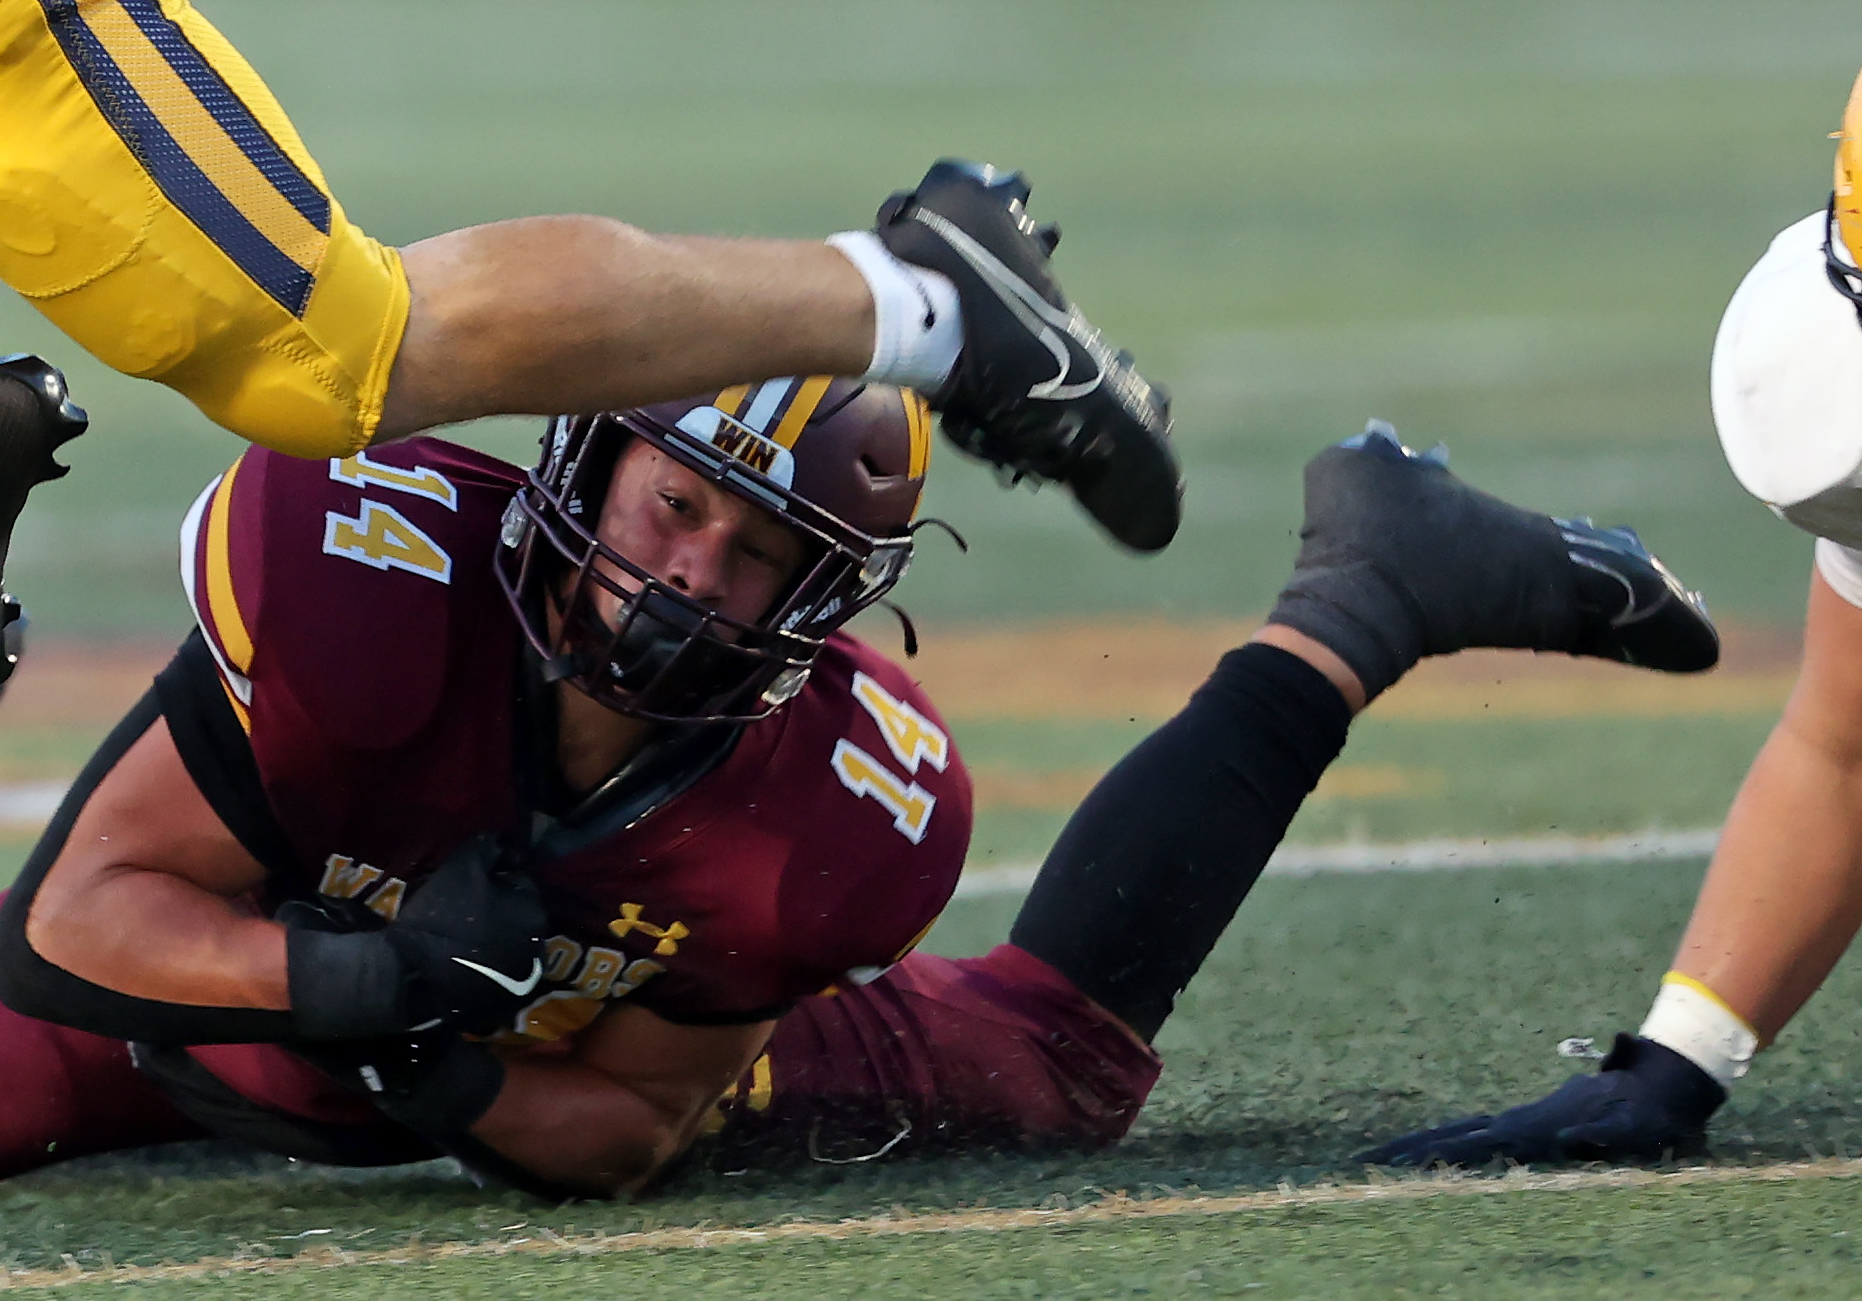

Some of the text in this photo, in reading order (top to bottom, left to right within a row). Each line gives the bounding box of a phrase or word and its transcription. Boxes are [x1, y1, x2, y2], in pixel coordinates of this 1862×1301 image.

[711, 416, 780, 475] WIN
[322, 451, 458, 585] 14
[830, 670, 950, 845] 14
